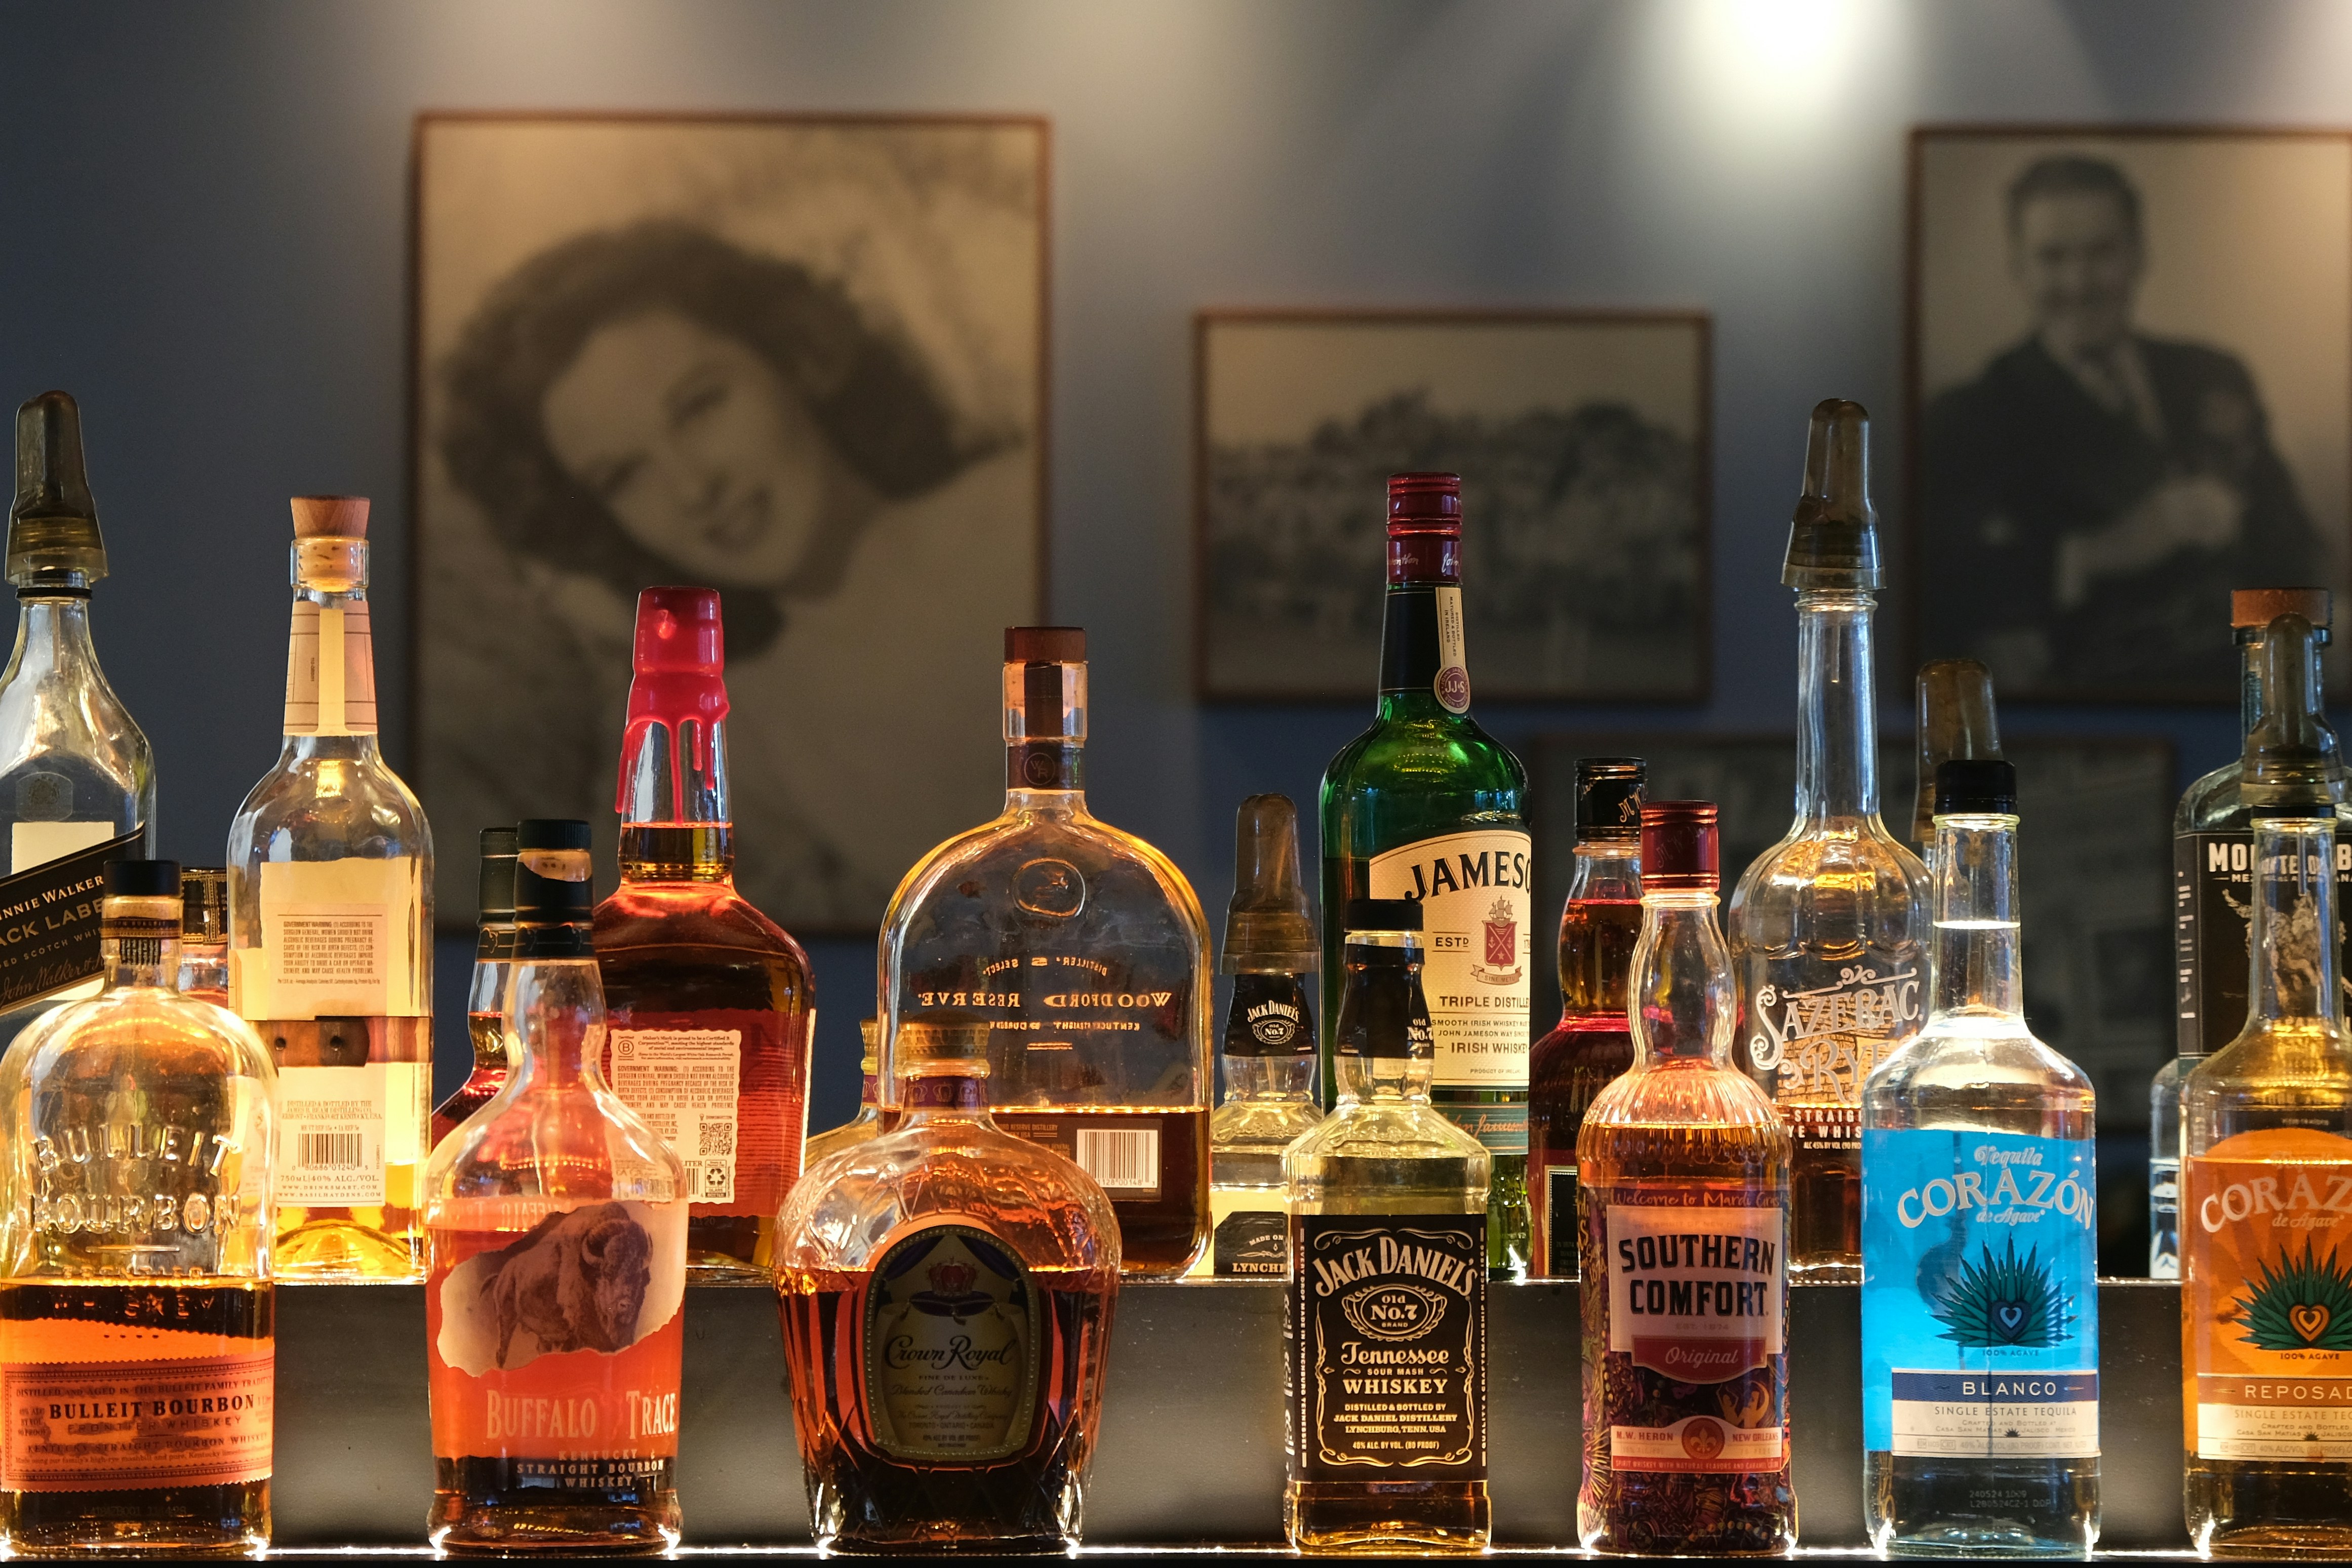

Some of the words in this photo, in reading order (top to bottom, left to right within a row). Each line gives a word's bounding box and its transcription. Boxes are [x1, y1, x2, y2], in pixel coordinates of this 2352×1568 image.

[42, 875, 104, 904] WALKER
[23, 939, 68, 960] SCOTCH
[1439, 995, 1490, 1008] TRIPLE
[1247, 1004, 1268, 1023] JACK
[1268, 999, 1300, 1023] DANIEL'S
[1413, 1018, 1426, 1026] Old
[1750, 981, 1921, 1070] SAZERAC
[1407, 1026, 1433, 1041] No.7
[1451, 1042, 1489, 1054] IRISH
[30, 1122, 241, 1177] BULLEIT
[1973, 1145, 2043, 1167] Tequila
[1610, 1190, 1679, 1207] Welcome
[1683, 1192, 1697, 1206] to
[1703, 1191, 1751, 1207] Mardi
[1897, 1169, 2094, 1230] CORAZÓN
[30, 1192, 241, 1235] BOURBON
[1976, 1210, 1991, 1223] de
[1994, 1207, 2042, 1226] Agave
[2271, 1212, 2288, 1227] de
[2290, 1213, 2340, 1231] Agave
[1249, 1235, 1270, 1246] MADE
[1619, 1234, 1776, 1275] SOUTHERN
[1312, 1247, 1378, 1297] JACK
[1379, 1236, 1478, 1297] DANIEL'S
[1381, 1294, 1406, 1304] Old
[1629, 1279, 1767, 1317] COMFORT
[1370, 1304, 1418, 1320] No.7
[1301, 1330, 1306, 1340] IN
[884, 1335, 945, 1370] Crown
[931, 1335, 1016, 1371] Royal
[1340, 1341, 1450, 1365] Tennessee
[1665, 1346, 1739, 1370] Original
[1982, 1349, 2008, 1357] 100%
[2010, 1349, 2040, 1357] AGAVE
[16, 1388, 61, 1397] DISTILLED
[89, 1387, 115, 1396] AGED
[135, 1384, 152, 1394] THE
[158, 1383, 202, 1392] BULLEIT
[204, 1380, 238, 1391] FAMILY
[1342, 1379, 1448, 1394] WHISKEY
[1963, 1381, 2057, 1396] BLANCO
[49, 1401, 142, 1420] BULLEIT
[153, 1394, 254, 1417] BOURBON
[486, 1389, 597, 1440] BUFFALO
[626, 1390, 676, 1440] TRACE
[1344, 1403, 1387, 1412] DISTILLED
[1934, 1406, 1978, 1416] SINGLE
[1985, 1407, 2028, 1416] ESTATE
[2035, 1407, 2077, 1417] TEQUILA
[2235, 1410, 2276, 1419] SINGLE
[2282, 1411, 2327, 1420] ESTATE
[68, 1421, 157, 1435] FRONTIER
[166, 1416, 242, 1429] WHISKEY
[1333, 1414, 1359, 1422] JACK
[1361, 1414, 1398, 1422] DANIEL
[1399, 1414, 1458, 1422] DISTILLERY
[1428, 1425, 1446, 1433] USA
[1639, 1432, 1673, 1442] HERON
[1732, 1433, 1752, 1442] NEW
[1752, 1432, 1779, 1442] ORLEANS
[28, 1443, 88, 1454] KENTUCKY
[95, 1442, 159, 1452] STRAIGHT
[166, 1437, 225, 1450] BOURBON
[230, 1433, 268, 1444] WHISKEY
[558, 1449, 638, 1461] KENTUCKY
[516, 1464, 599, 1475] STRAIGHT
[608, 1459, 664, 1474] BOURBON
[564, 1477, 633, 1489] WHISKEY
